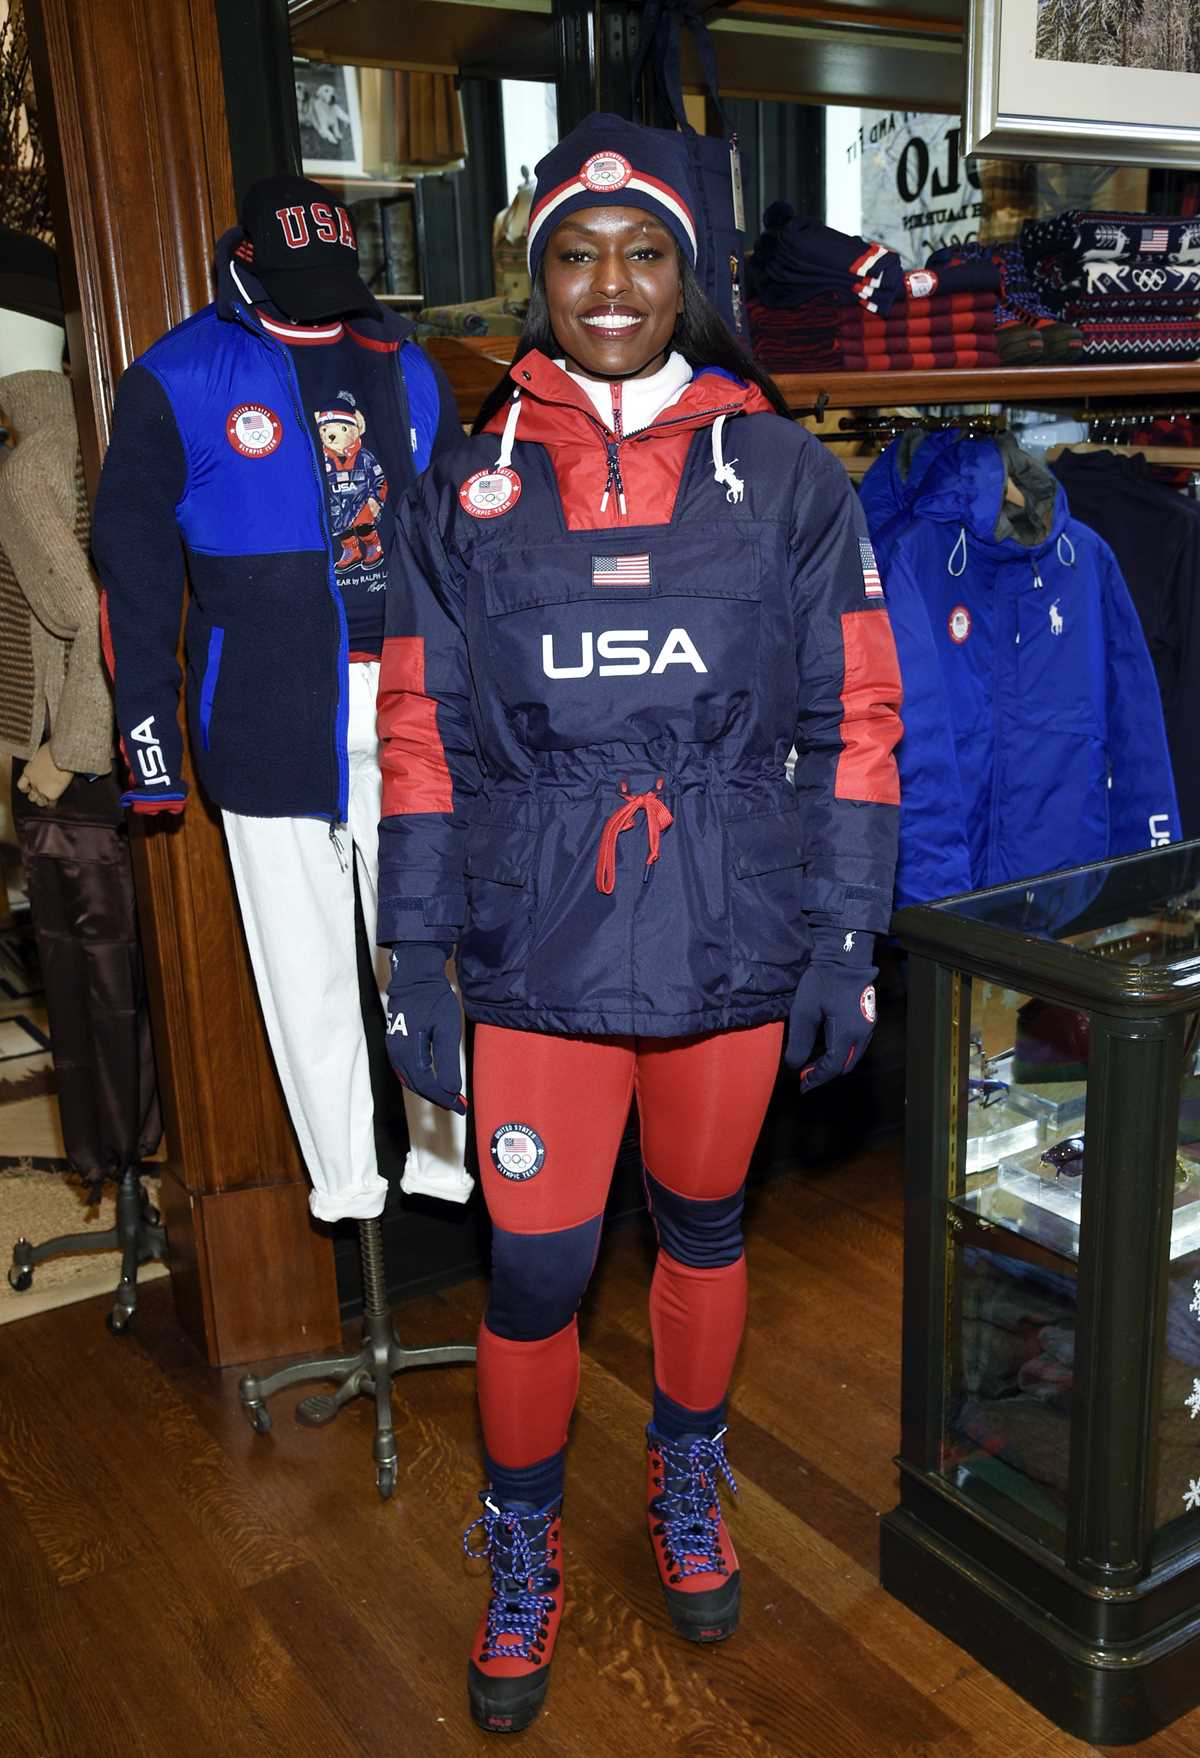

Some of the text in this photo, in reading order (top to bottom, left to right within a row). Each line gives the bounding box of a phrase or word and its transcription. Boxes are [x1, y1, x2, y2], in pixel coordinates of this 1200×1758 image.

[275, 202, 357, 251] USA
[331, 482, 358, 493] USA
[335, 577, 351, 586] EAR
[352, 577, 360, 586] by
[360, 572, 381, 584] RALPH
[542, 628, 709, 680] USA
[494, 1124, 537, 1140] UNITED STATES
[497, 1163, 539, 1180] OLYMPIC TEAM
